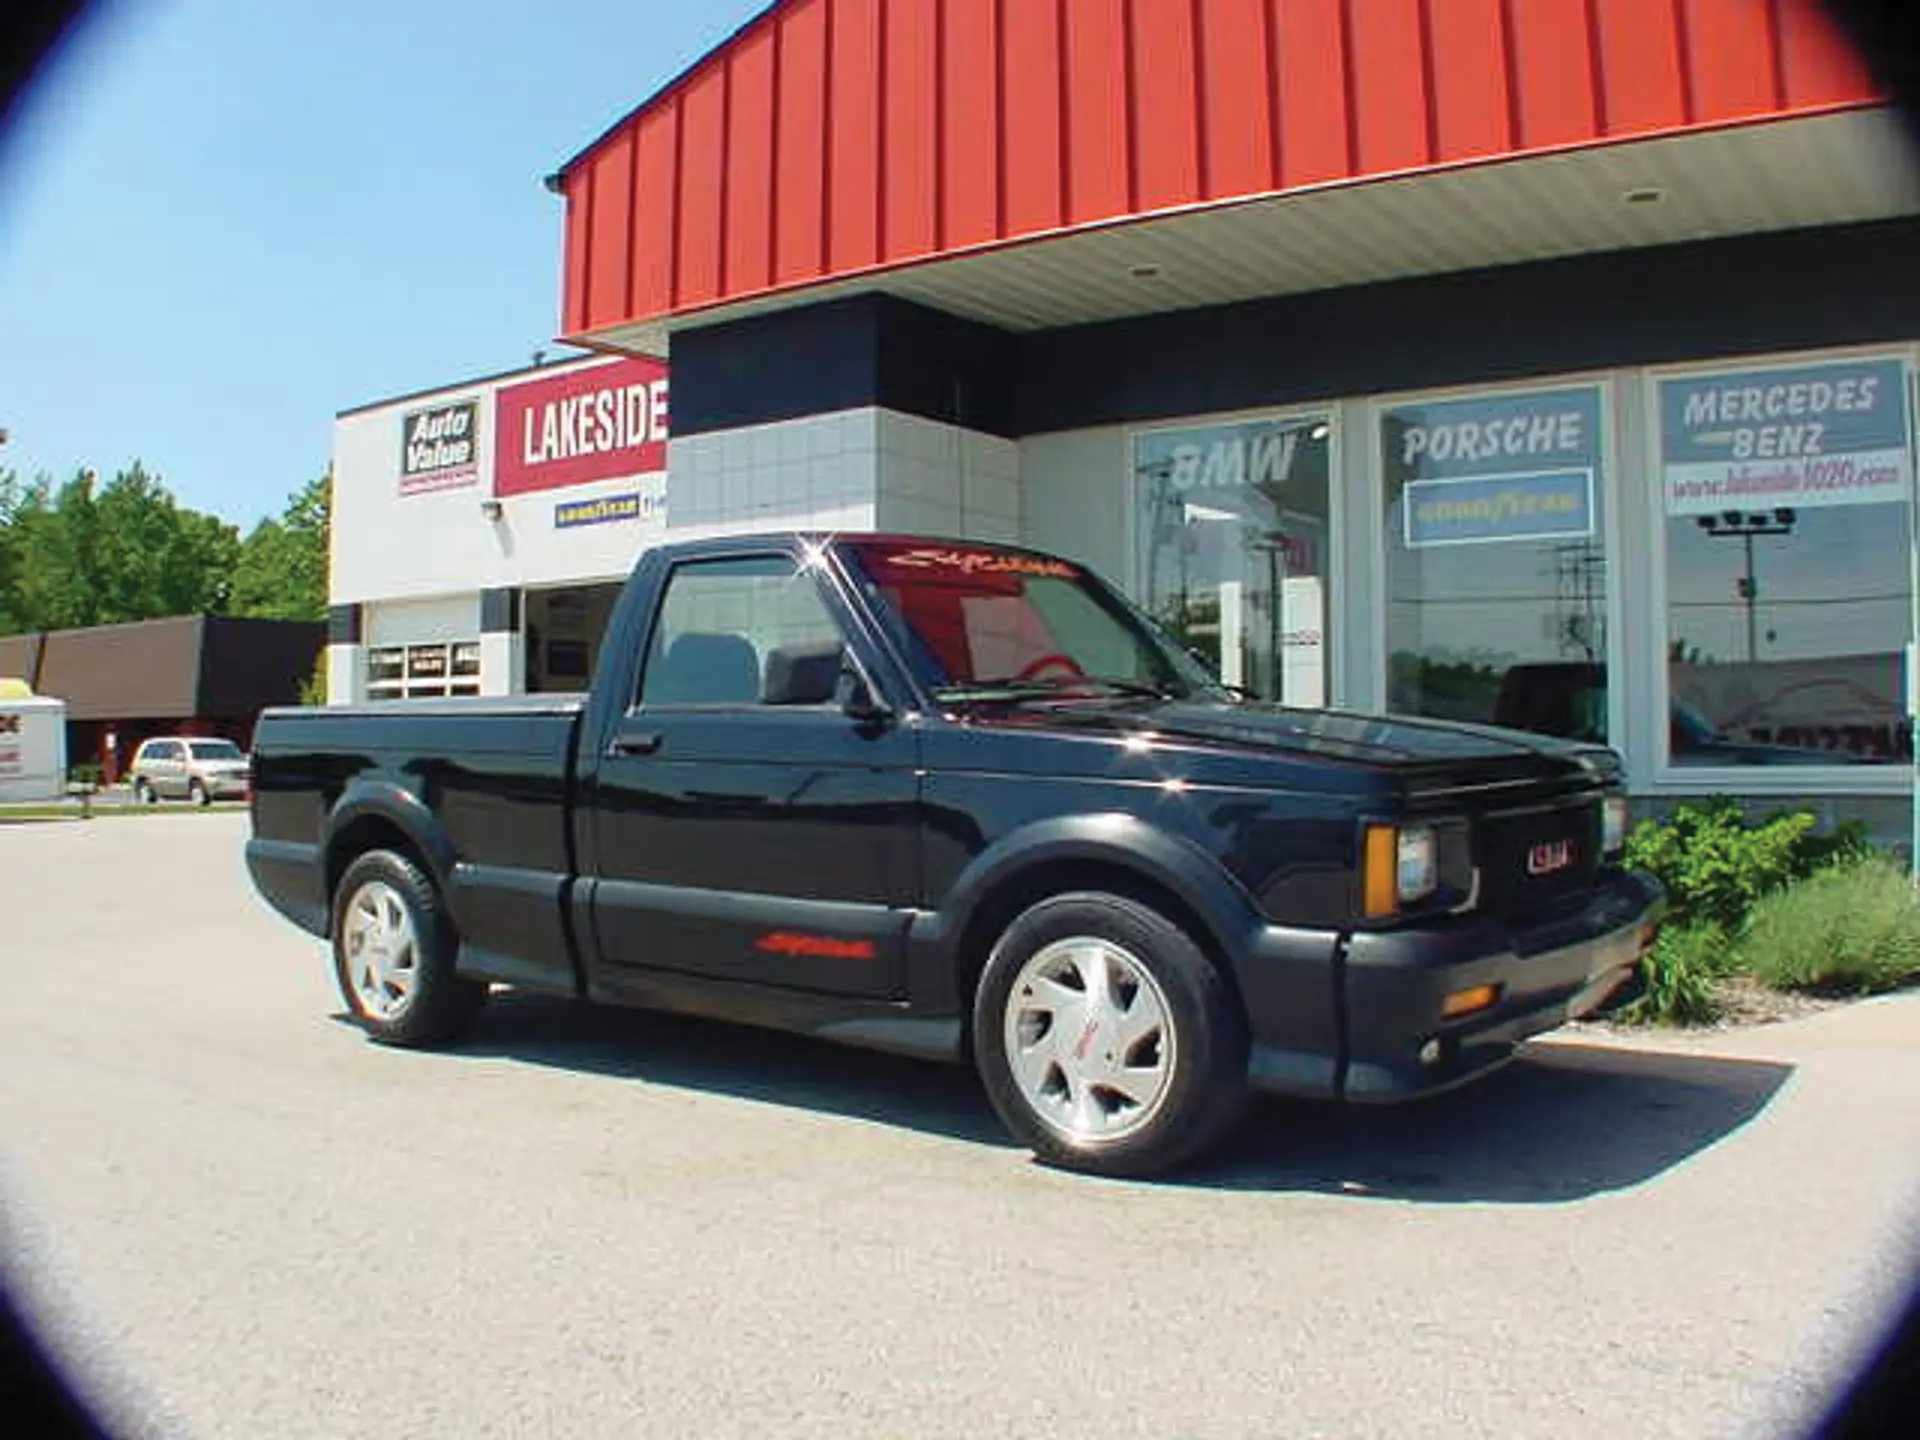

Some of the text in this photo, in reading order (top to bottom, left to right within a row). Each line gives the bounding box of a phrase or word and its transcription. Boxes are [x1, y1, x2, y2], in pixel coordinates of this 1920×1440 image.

[411, 407, 469, 442] Auto
[524, 379, 668, 465] LAKESIDE
[1684, 377, 1879, 425] MERCEDES
[407, 439, 469, 472] Value
[1171, 430, 1299, 490] BMW
[1402, 412, 1583, 464] PORSCHE
[1732, 422, 1825, 458] BENZ
